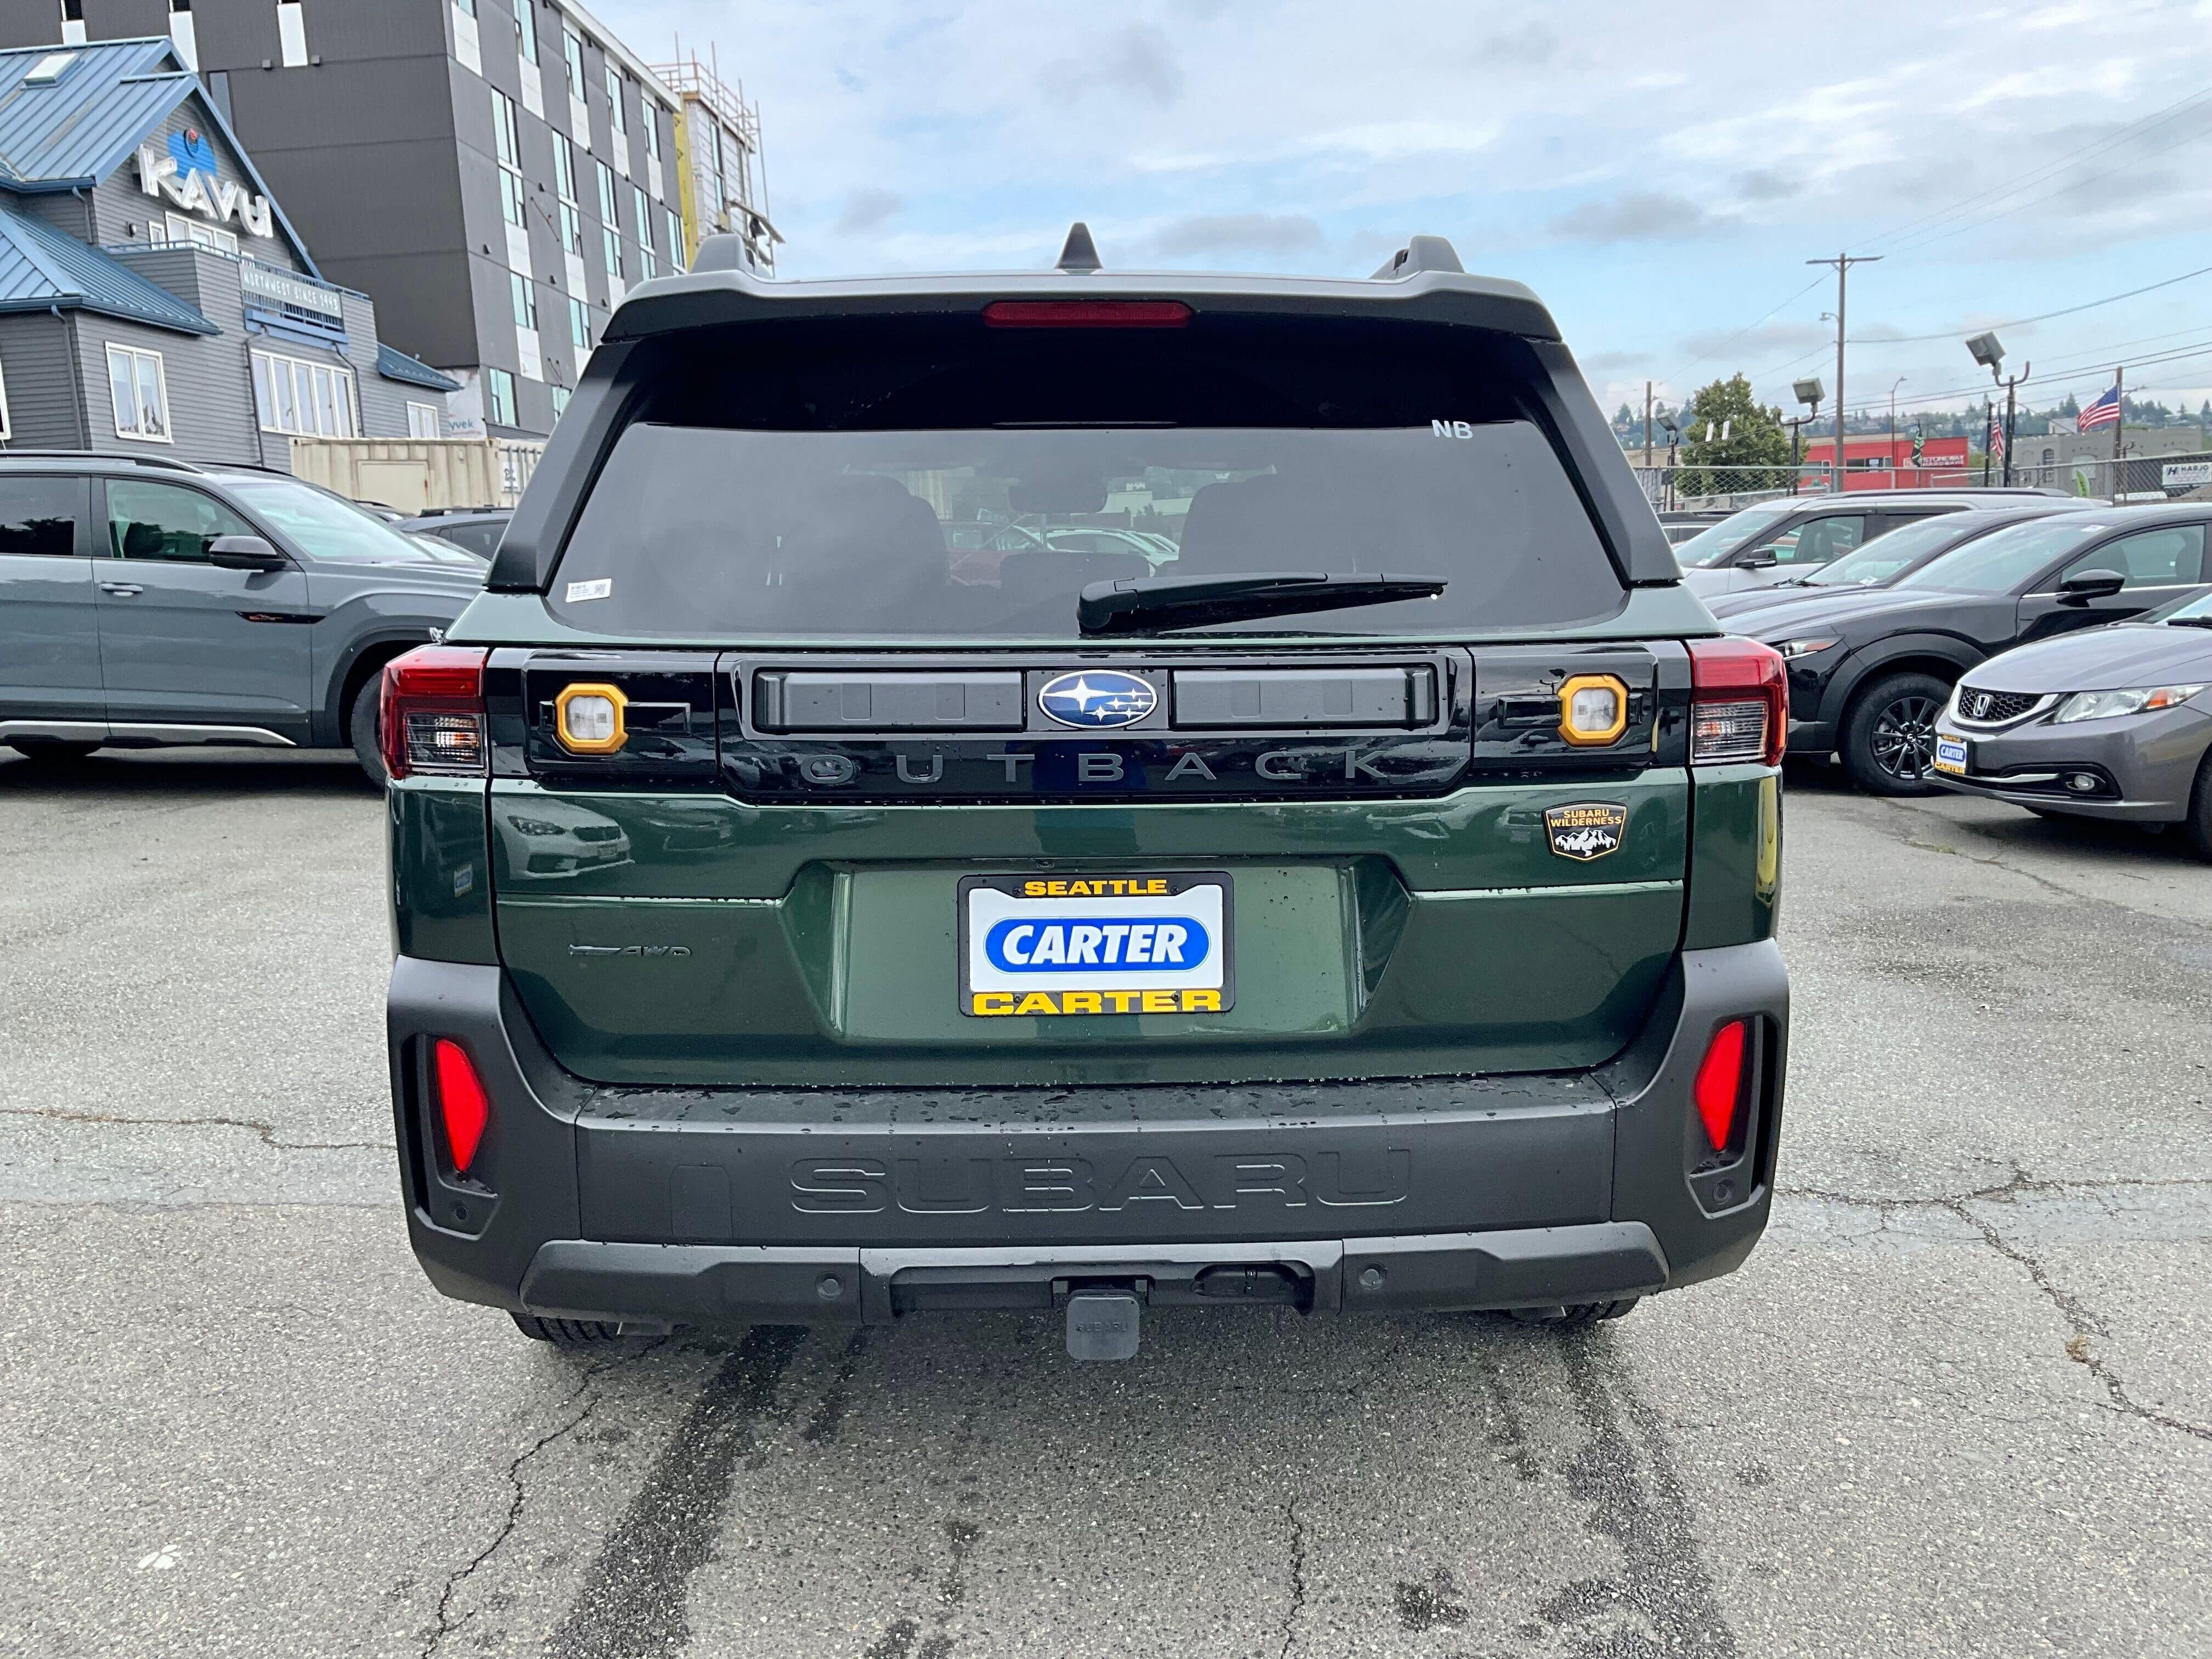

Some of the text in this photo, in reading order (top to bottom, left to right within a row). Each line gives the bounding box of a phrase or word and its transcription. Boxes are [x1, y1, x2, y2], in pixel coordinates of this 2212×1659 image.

[139, 144, 273, 238] KAVU
[244, 272, 338, 312] NORTHWEST SINCE 1993
[1431, 419, 1474, 439] NB
[1940, 746, 1963, 761] CARTER
[800, 750, 1388, 784] OUTBACK
[1934, 761, 1965, 774] CARTER
[1550, 816, 1622, 827] WILDERNESS
[1564, 809, 1610, 819] SUBARU
[1024, 879, 1167, 896] SEATTLE
[1002, 924, 1188, 965] CARTER
[973, 990, 1221, 1015] CARTER
[790, 1149, 1411, 1214] SUBARU
